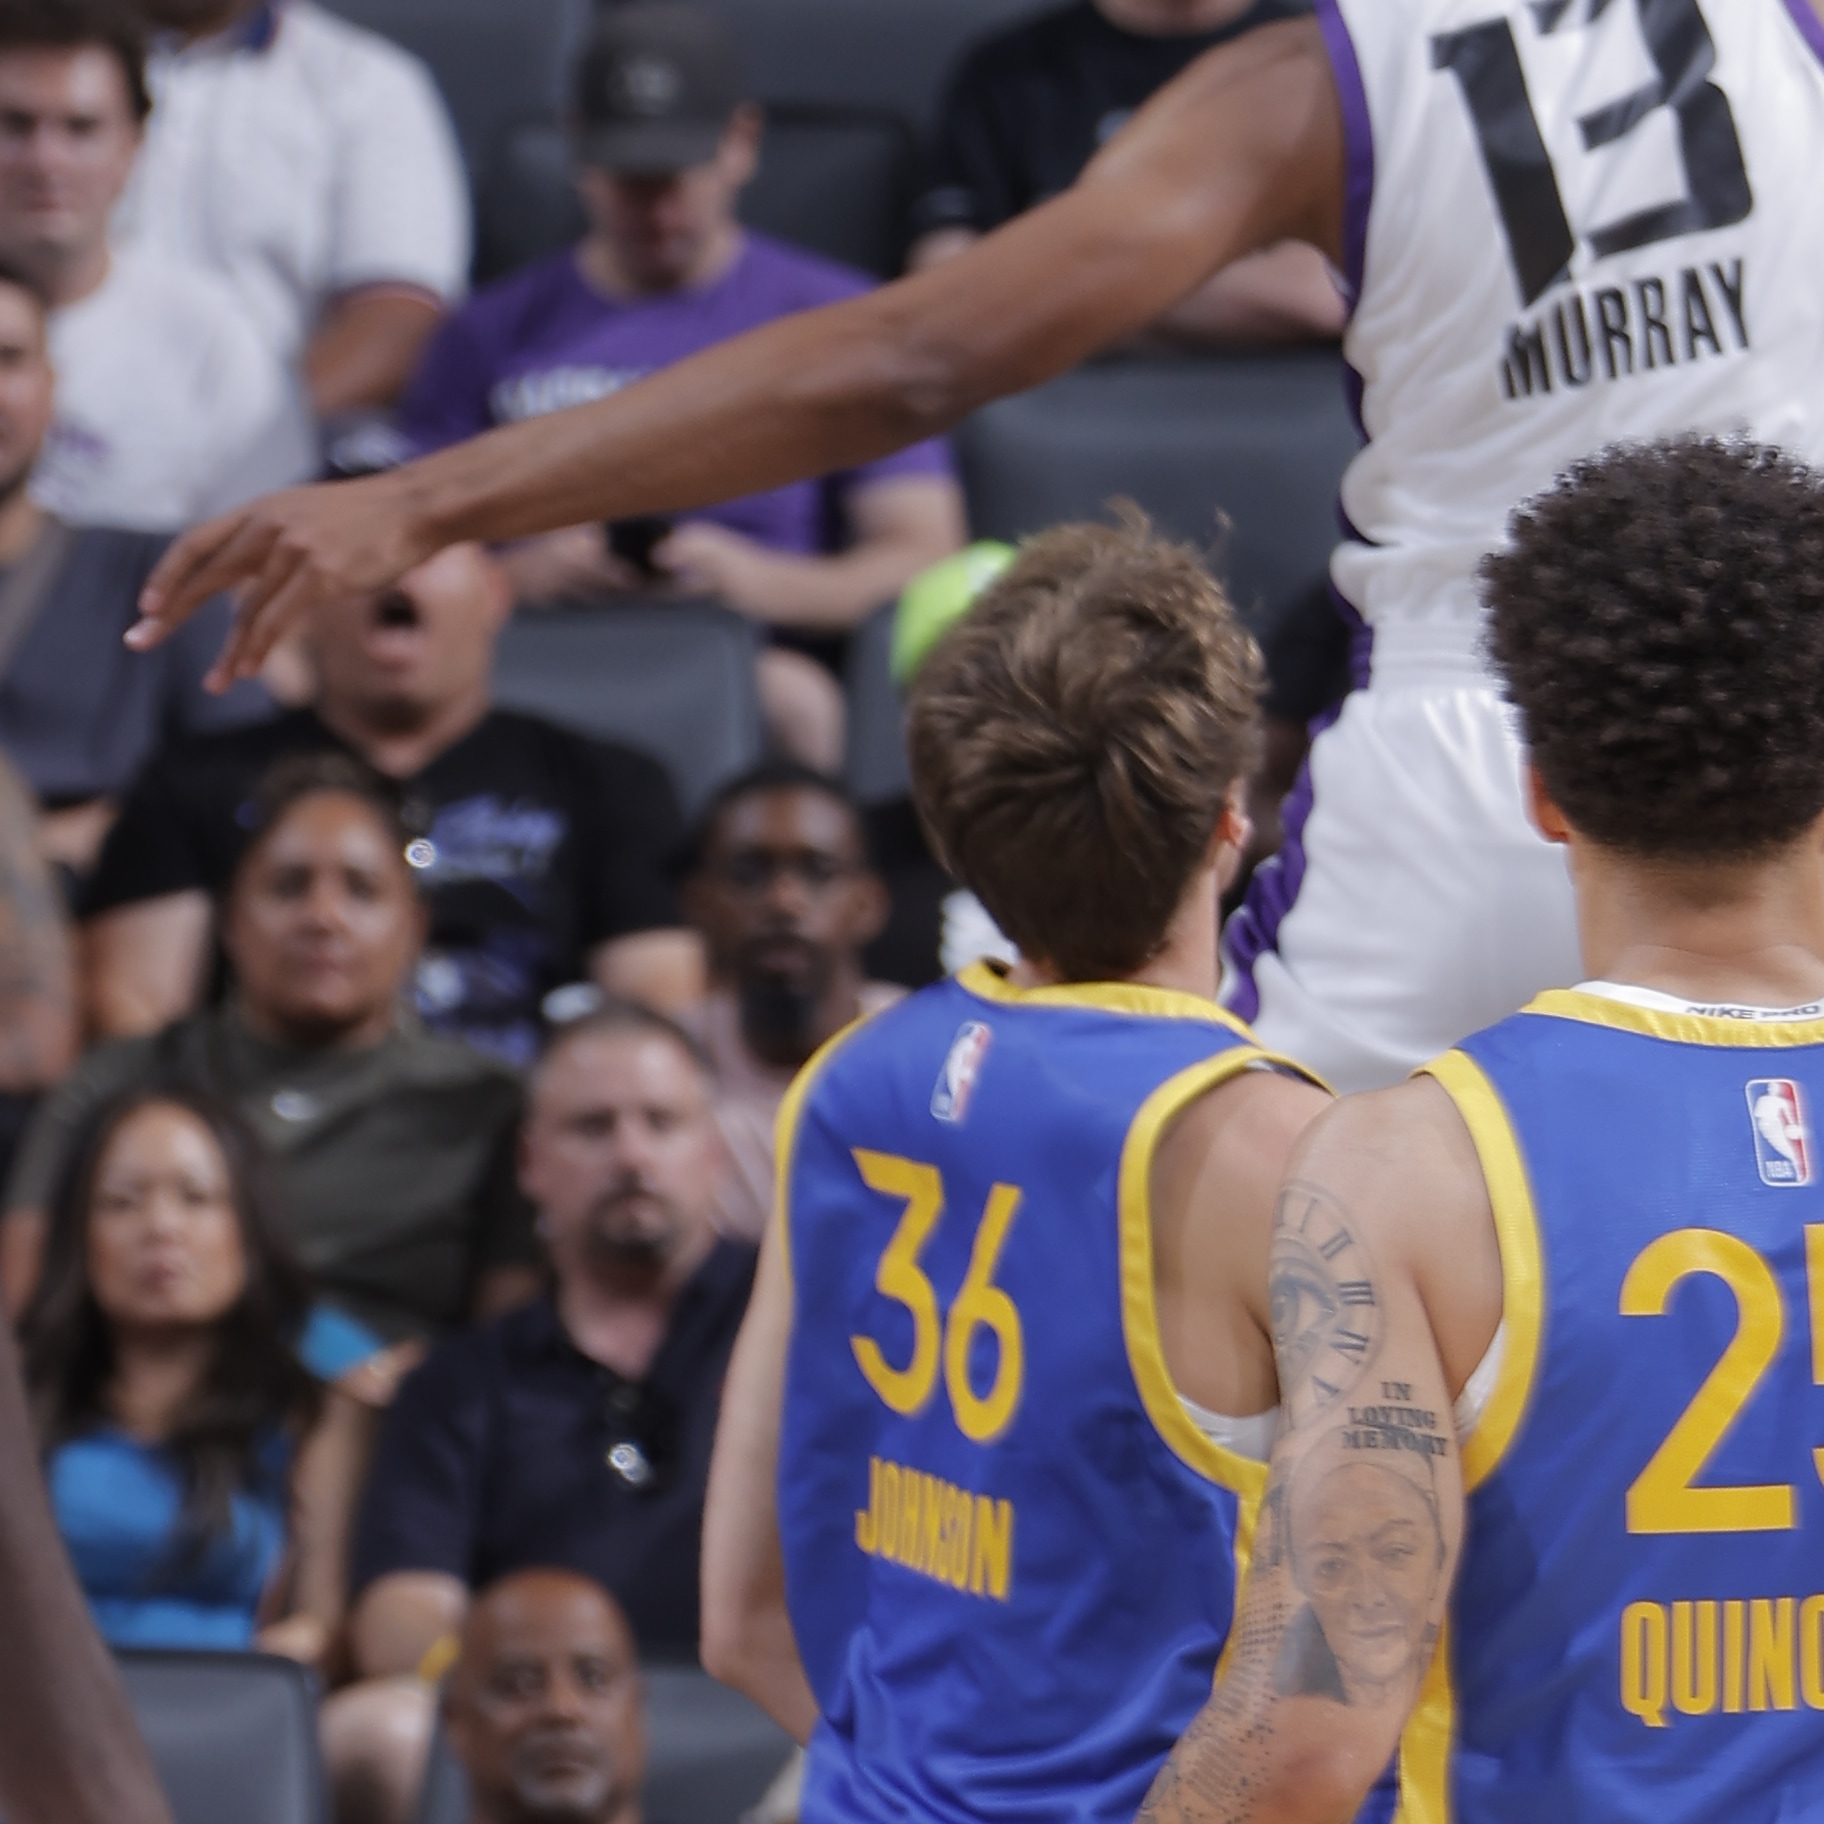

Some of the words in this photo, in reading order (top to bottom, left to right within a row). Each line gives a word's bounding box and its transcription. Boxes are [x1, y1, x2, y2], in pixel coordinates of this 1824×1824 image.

[1503, 256, 1750, 402] MURRAY
[1685, 1005, 1755, 1020] NIKE
[851, 1146, 1023, 1444] 36
[1380, 1380, 1412, 1402] IN
[1347, 1406, 1437, 1428] LOVING
